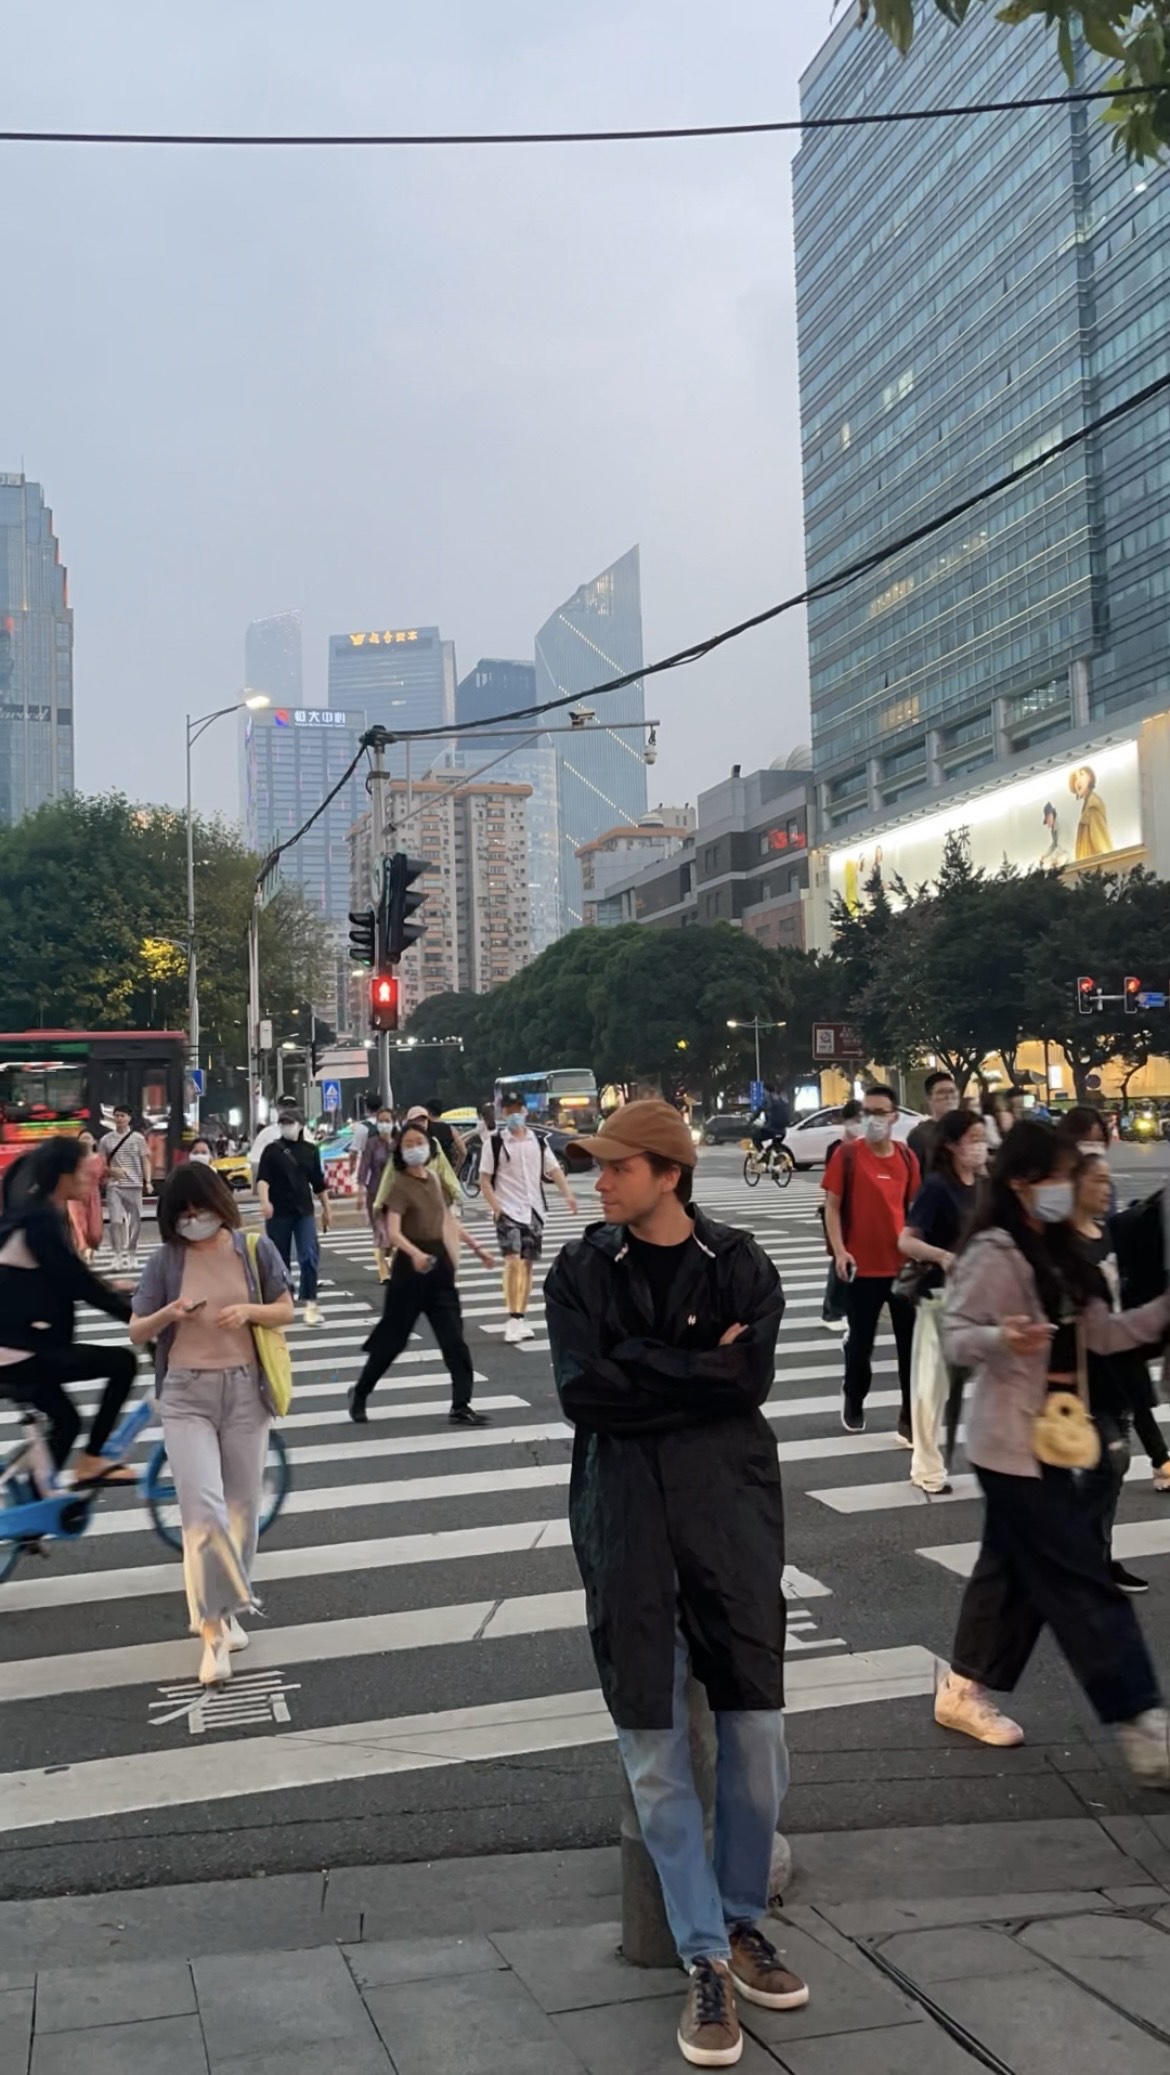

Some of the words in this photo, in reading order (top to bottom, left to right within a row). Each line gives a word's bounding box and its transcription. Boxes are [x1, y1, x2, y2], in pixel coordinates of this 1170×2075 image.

[294, 710, 346, 724] 恒大中心
[147, 1671, 301, 1734] 看
